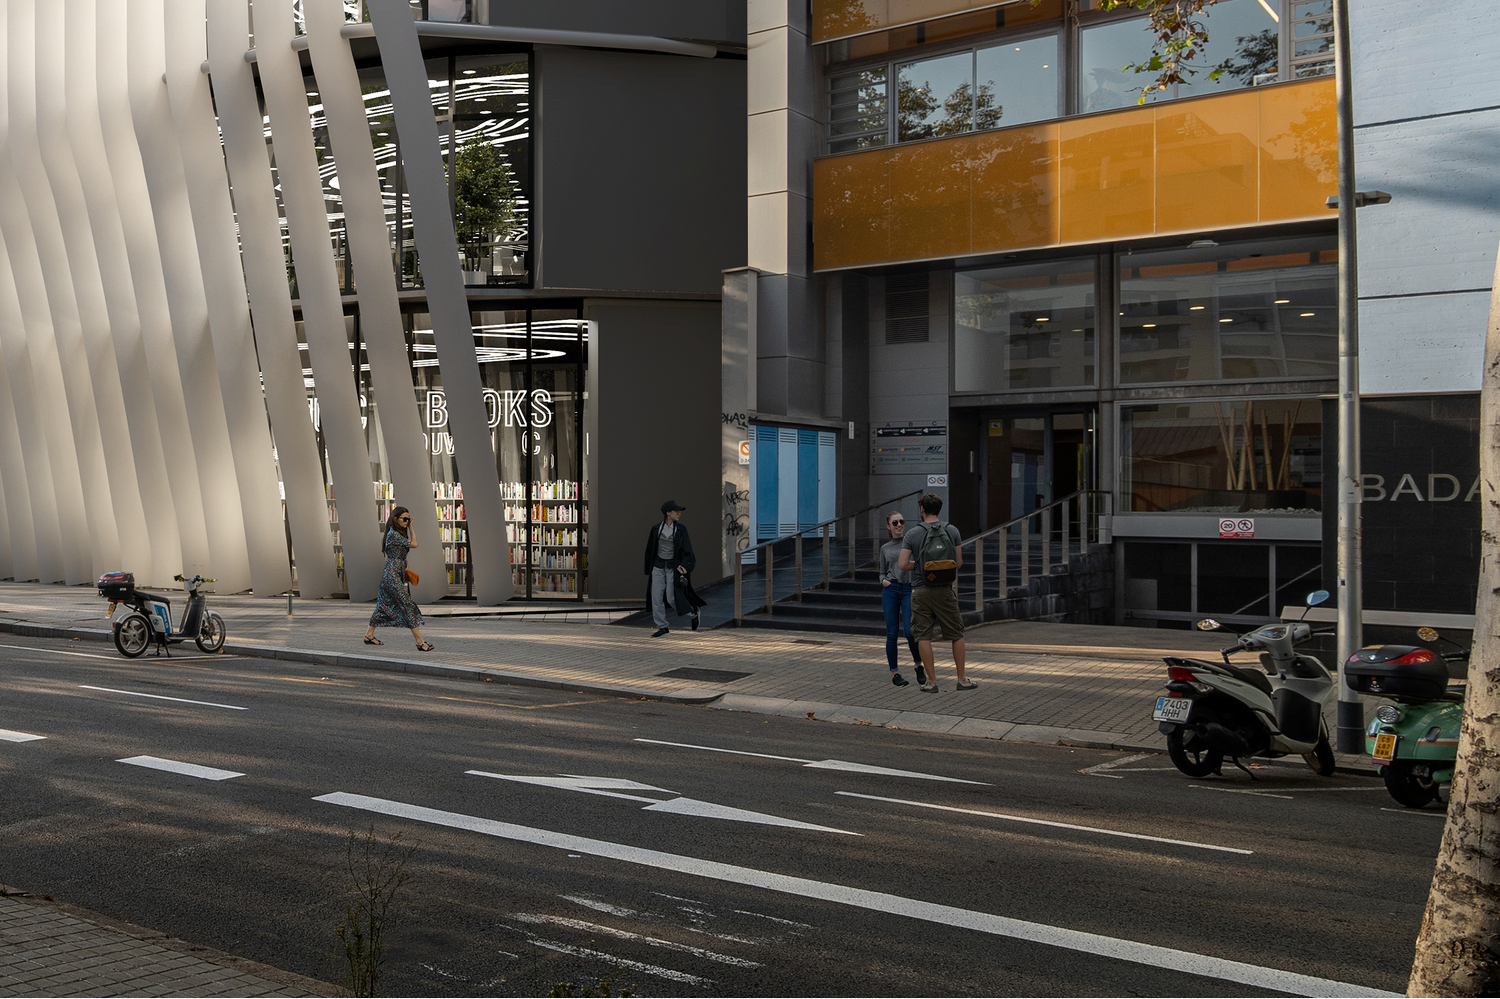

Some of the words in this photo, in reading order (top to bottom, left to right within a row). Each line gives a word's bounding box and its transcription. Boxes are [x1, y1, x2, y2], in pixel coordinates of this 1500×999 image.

[426, 388, 552, 428] BOKS
[1163, 699, 1189, 710] 7403
[1160, 708, 1181, 718] HHH
